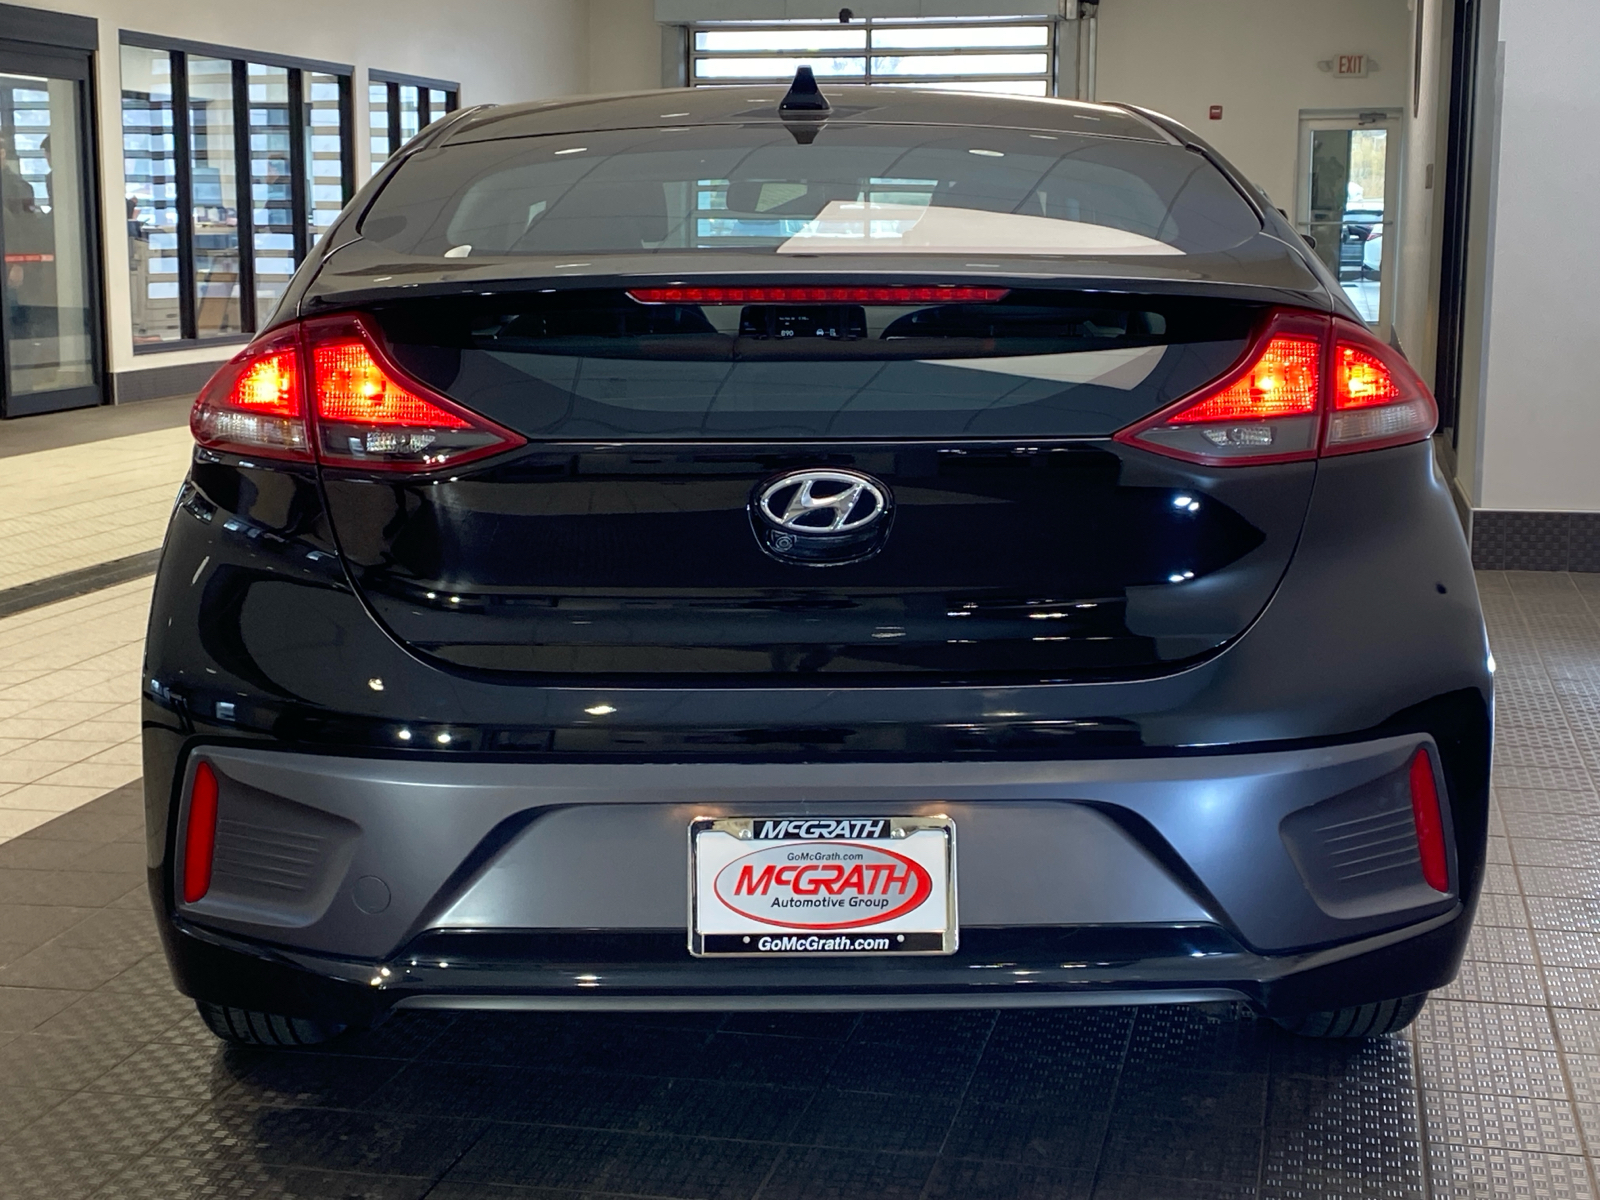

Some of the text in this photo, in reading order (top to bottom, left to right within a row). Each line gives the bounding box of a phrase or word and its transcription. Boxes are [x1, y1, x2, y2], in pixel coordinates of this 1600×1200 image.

[1339, 56, 1363, 73] EXIT
[787, 852, 863, 861] GoMcGrath.com
[770, 897, 889, 909] Automotive Group
[758, 937, 889, 951] GoMcGrath.com
